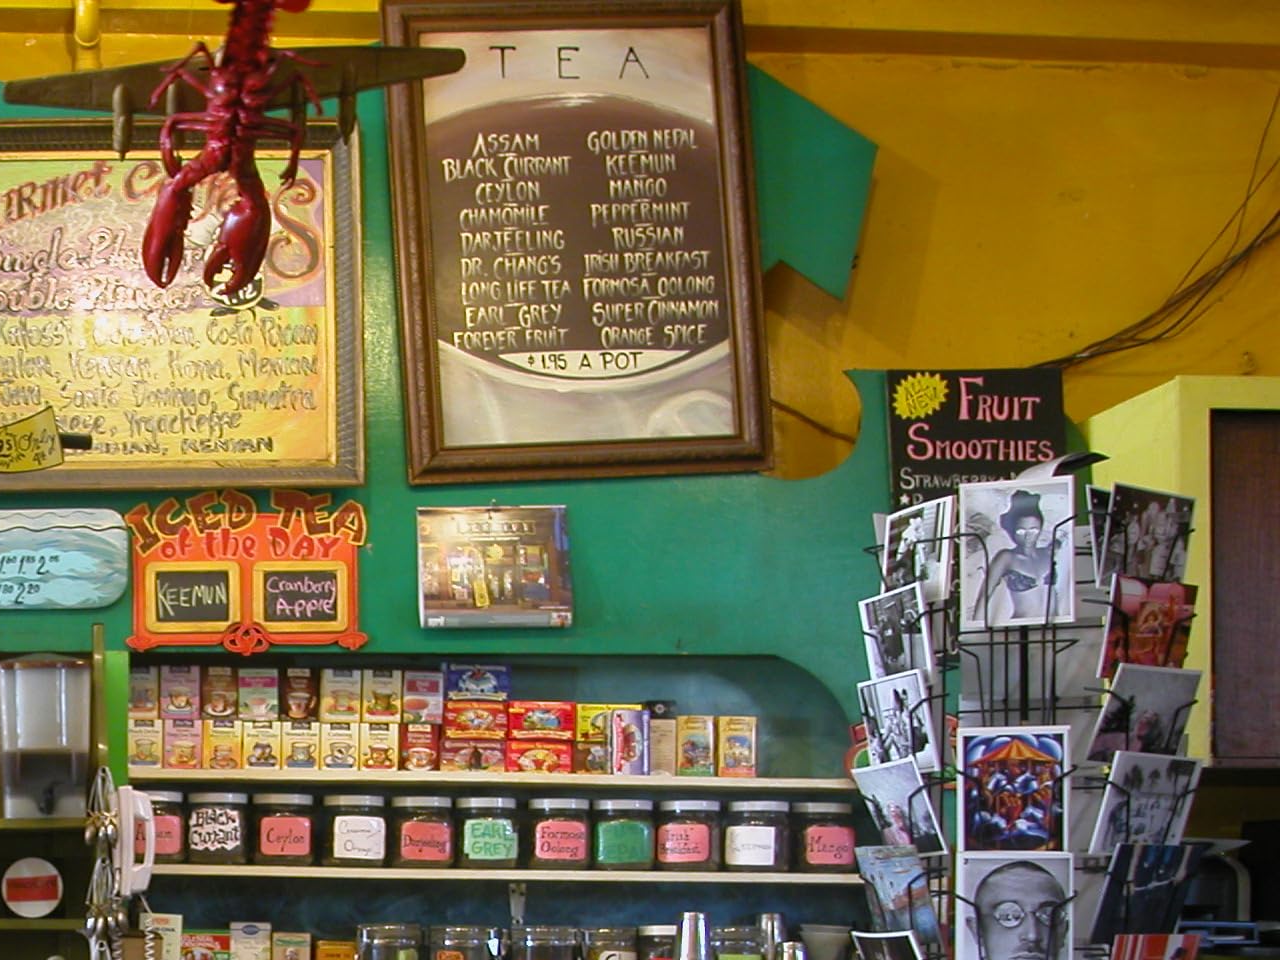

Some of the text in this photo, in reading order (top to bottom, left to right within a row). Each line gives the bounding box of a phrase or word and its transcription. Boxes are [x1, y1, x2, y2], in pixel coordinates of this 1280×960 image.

[472, 133, 540, 157] ASSAM
[587, 129, 698, 152] GOLDEN NEPAL
[442, 156, 571, 182] BLACK CURRANT
[606, 154, 676, 175] KEEMUN
[475, 182, 540, 204] CEYLON
[610, 179, 667, 198] MANGO
[460, 205, 549, 230] CHAMOMILE
[591, 203, 690, 226] PEPPERMINT
[460, 231, 564, 252] DARJEELING
[612, 227, 684, 249] RUSSIAN
[624, 250, 709, 271] BREAKFAST
[462, 281, 500, 304] LONG
[541, 280, 571, 297] TEA
[583, 276, 715, 299] FORMOSA OOLONG
[466, 304, 562, 328] EARL GREY
[593, 300, 719, 326] SUPER CINNAMON
[453, 327, 569, 350] FOREVER FRUIT
[601, 325, 707, 349] ORANGE SPICE
[579, 352, 643, 369] A POT
[959, 377, 1041, 422] FRUIT
[907, 422, 1056, 462] SMOOTHIES
[125, 489, 367, 555] ICED TEA
[160, 527, 342, 559] of the DAY
[156, 578, 228, 618] KEEMUN
[275, 598, 335, 618] Apple
[266, 828, 305, 851] Ceylon
[472, 841, 512, 857] GREY
